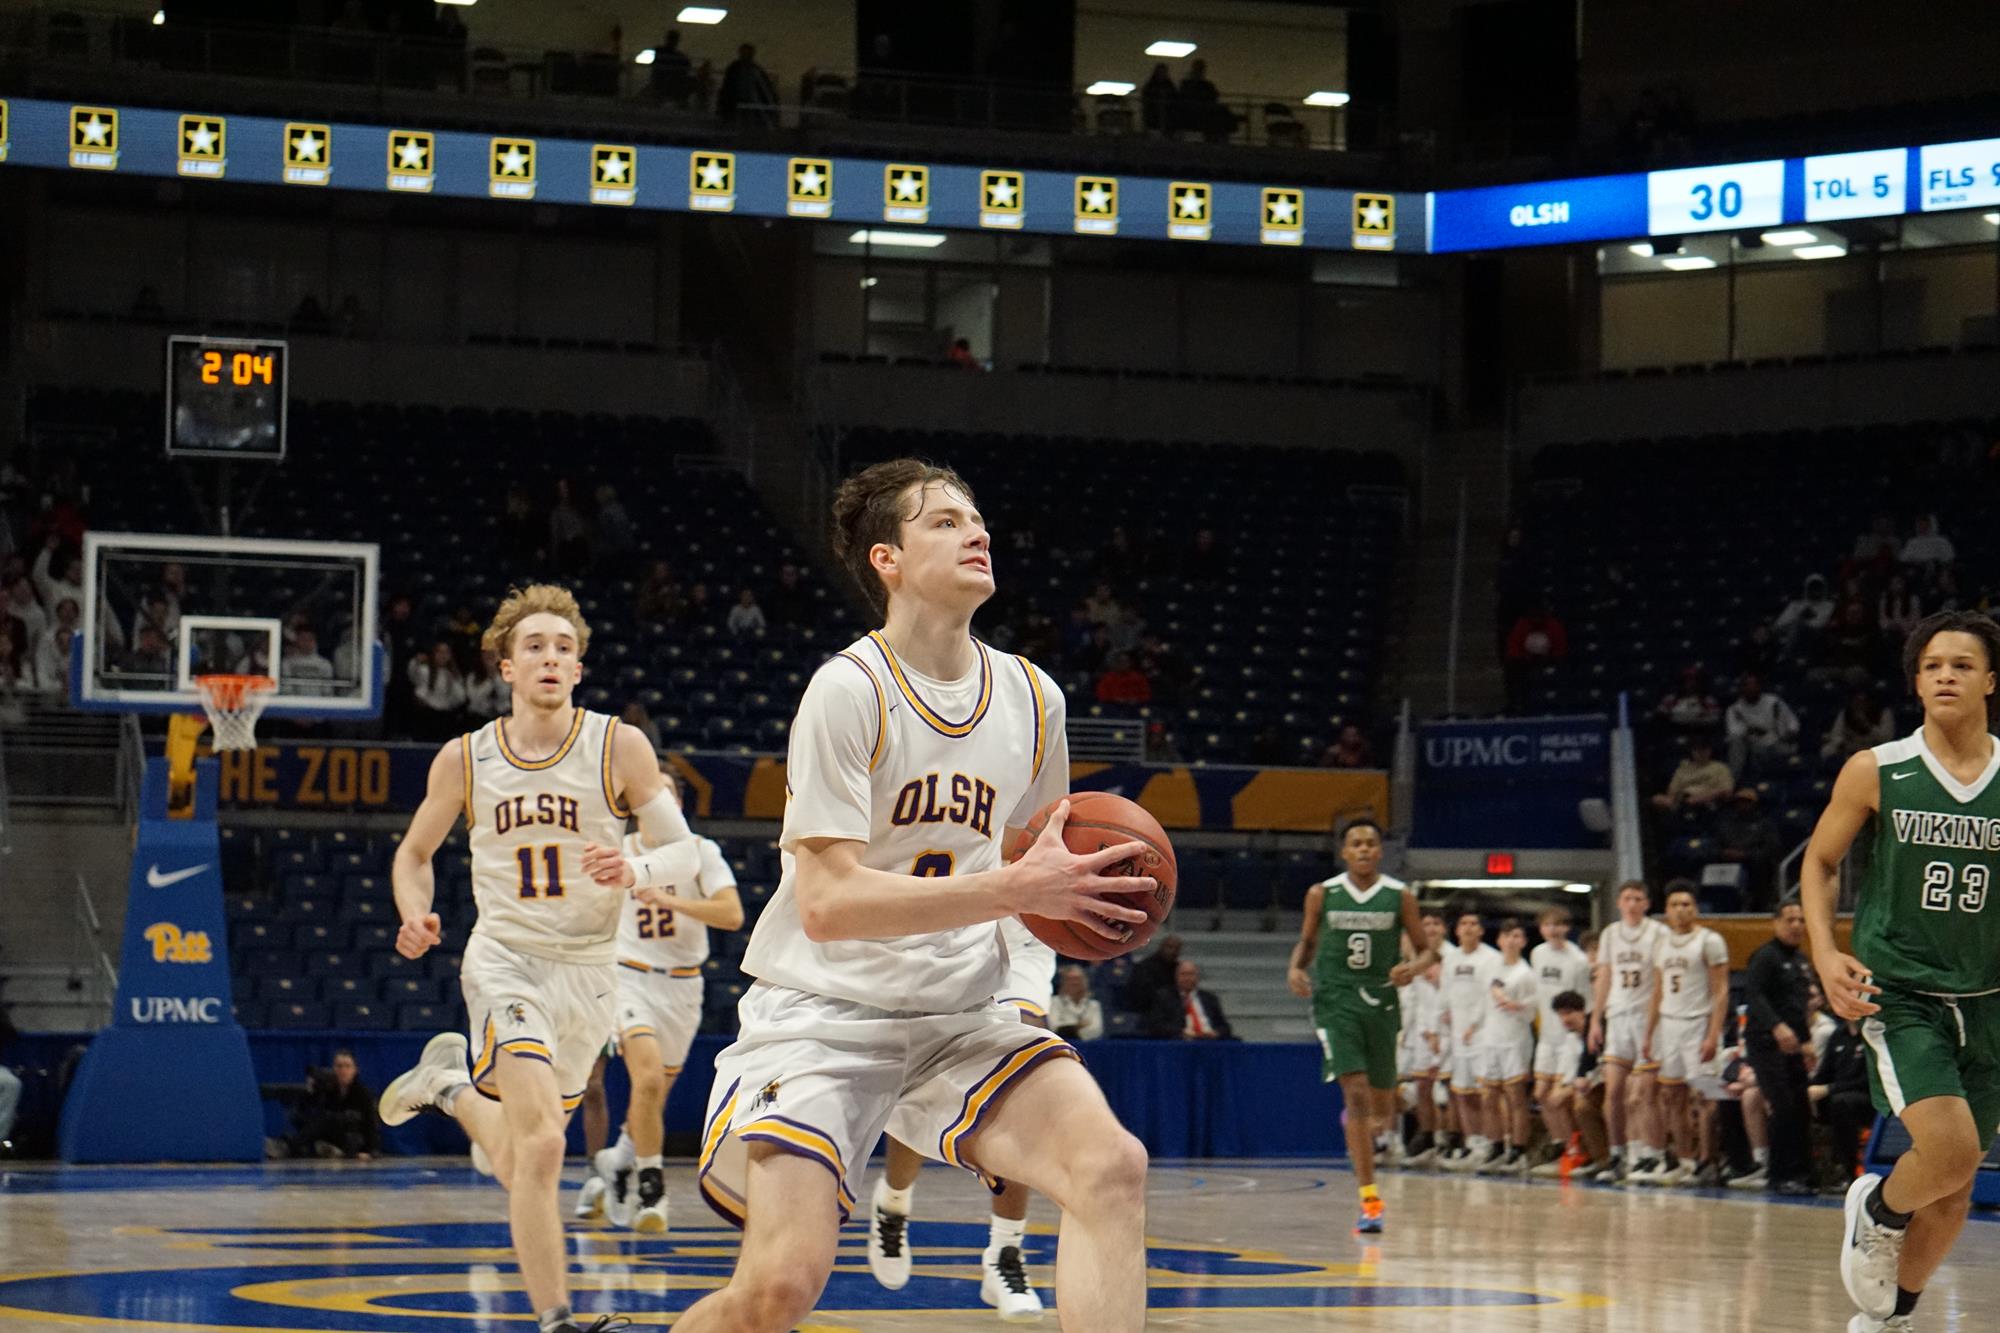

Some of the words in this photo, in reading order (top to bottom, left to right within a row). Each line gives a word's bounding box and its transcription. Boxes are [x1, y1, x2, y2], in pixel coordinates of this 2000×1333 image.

[1813, 179, 1857, 199] TOL
[1873, 175, 1889, 198] 5
[1928, 167, 1975, 190] FLS
[1510, 201, 1570, 227] OLSH
[1689, 181, 1742, 220] 30
[1426, 735, 1528, 767] UPMC
[197, 745, 281, 801] HE
[296, 746, 390, 804] ZOO
[495, 794, 579, 835] OLSH
[891, 772, 996, 840] OLSH
[515, 844, 565, 898] 11
[1921, 861, 1990, 913] 23
[636, 907, 675, 938] 22
[144, 922, 212, 964] Pitt
[1347, 932, 1371, 969] 3
[131, 997, 221, 1023] UPMC
